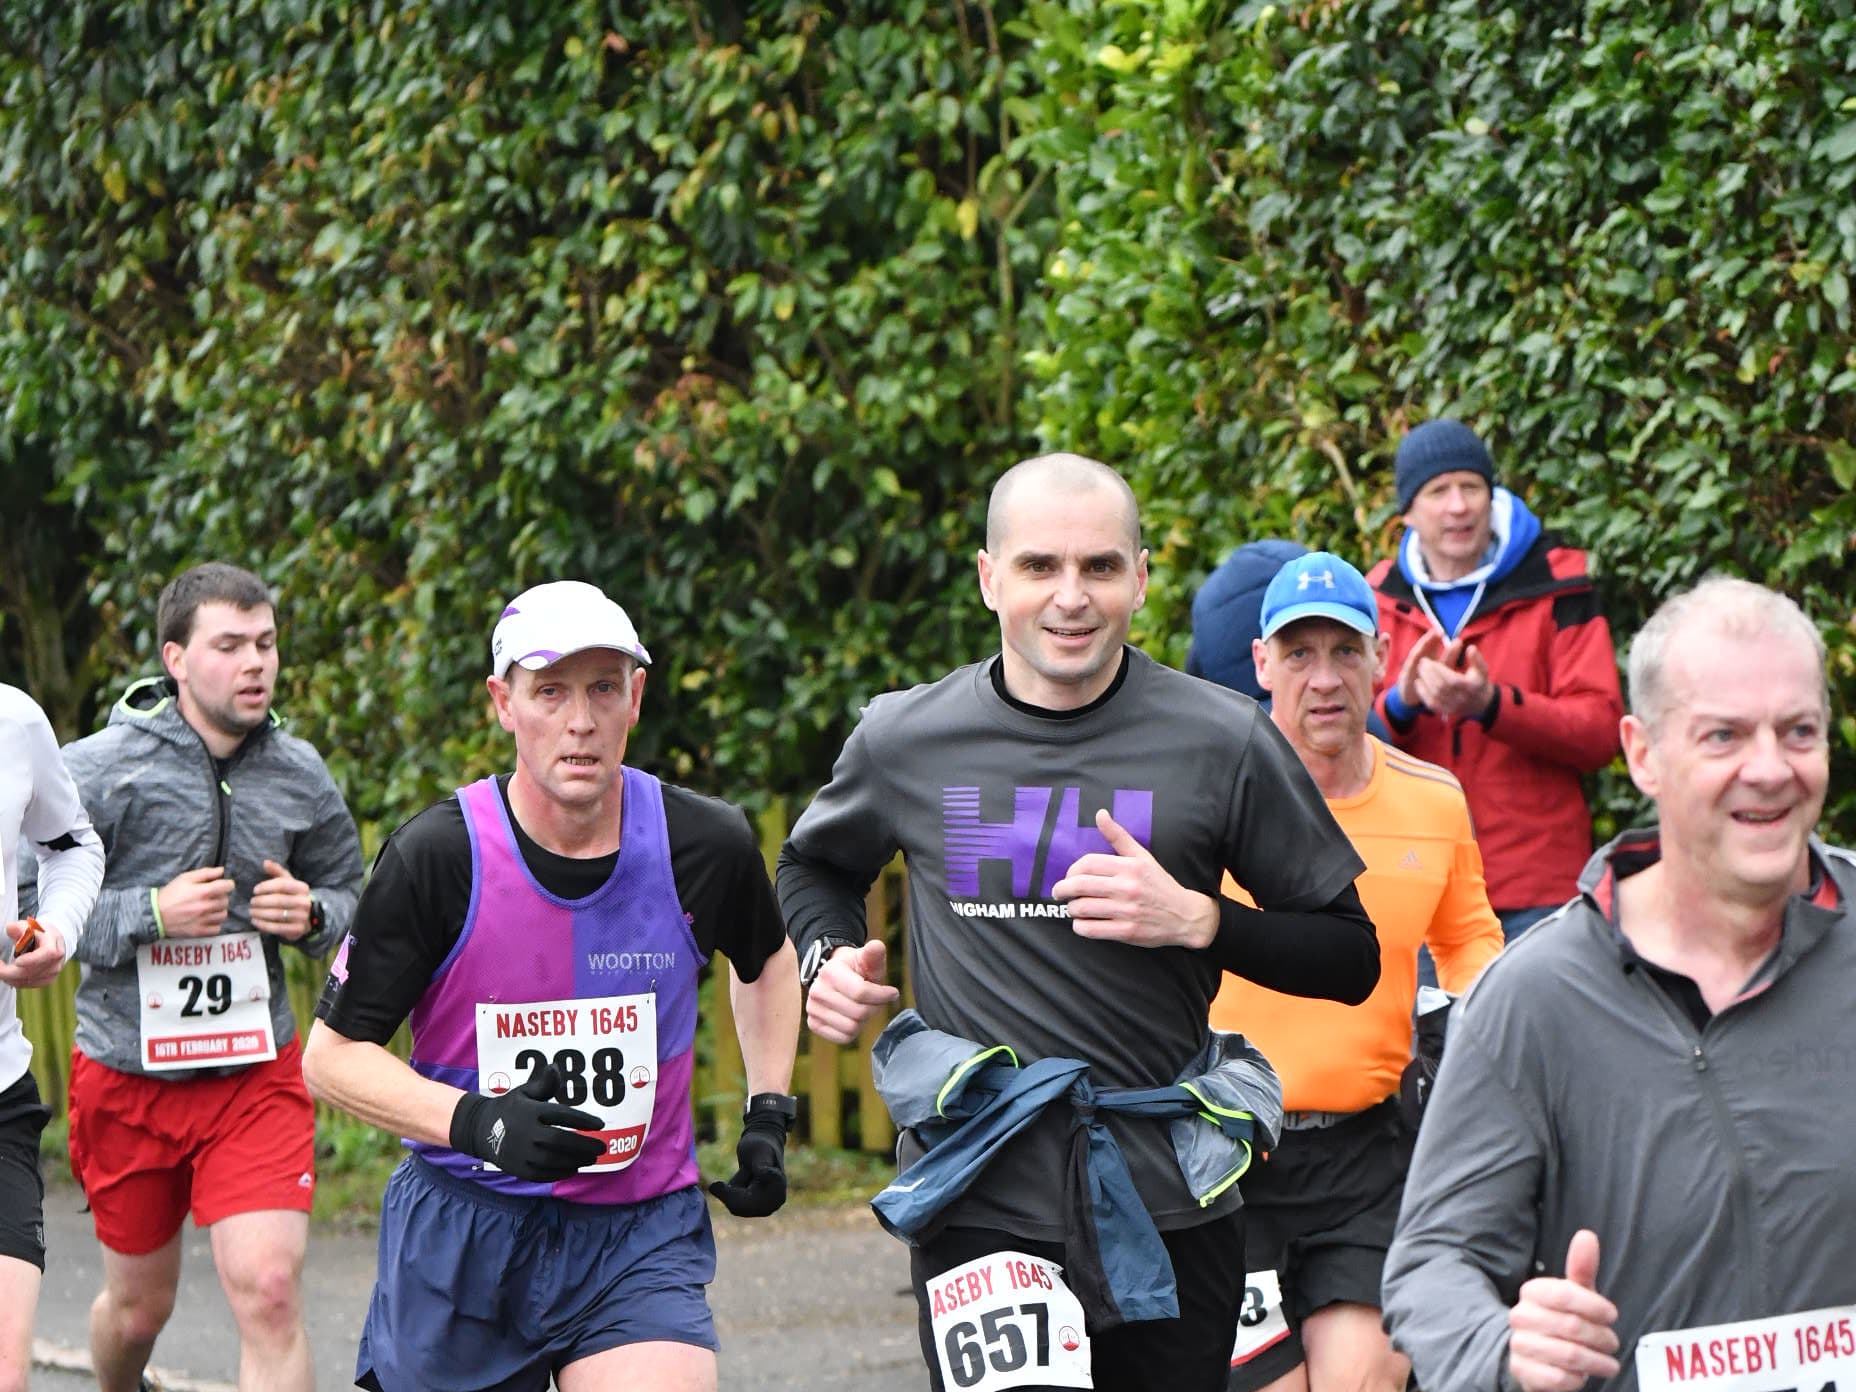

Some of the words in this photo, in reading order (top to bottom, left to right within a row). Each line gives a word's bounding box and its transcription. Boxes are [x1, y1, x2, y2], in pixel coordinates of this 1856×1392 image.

[1019, 903, 1071, 918] HARR
[151, 943, 212, 966] NASEBY
[221, 940, 252, 963] 1645
[588, 952, 675, 970] WOOTTON
[178, 974, 232, 1018] 29
[496, 1009, 579, 1039] NASEBY
[590, 1005, 639, 1036] 1645
[609, 1135, 637, 1155] 2020
[933, 1265, 994, 1319] ASEBY
[1005, 1261, 1053, 1291] 1645
[944, 1302, 1050, 1388] 657
[1664, 1332, 1778, 1383] NASEBY
[1794, 1318, 1856, 1366] 1645
